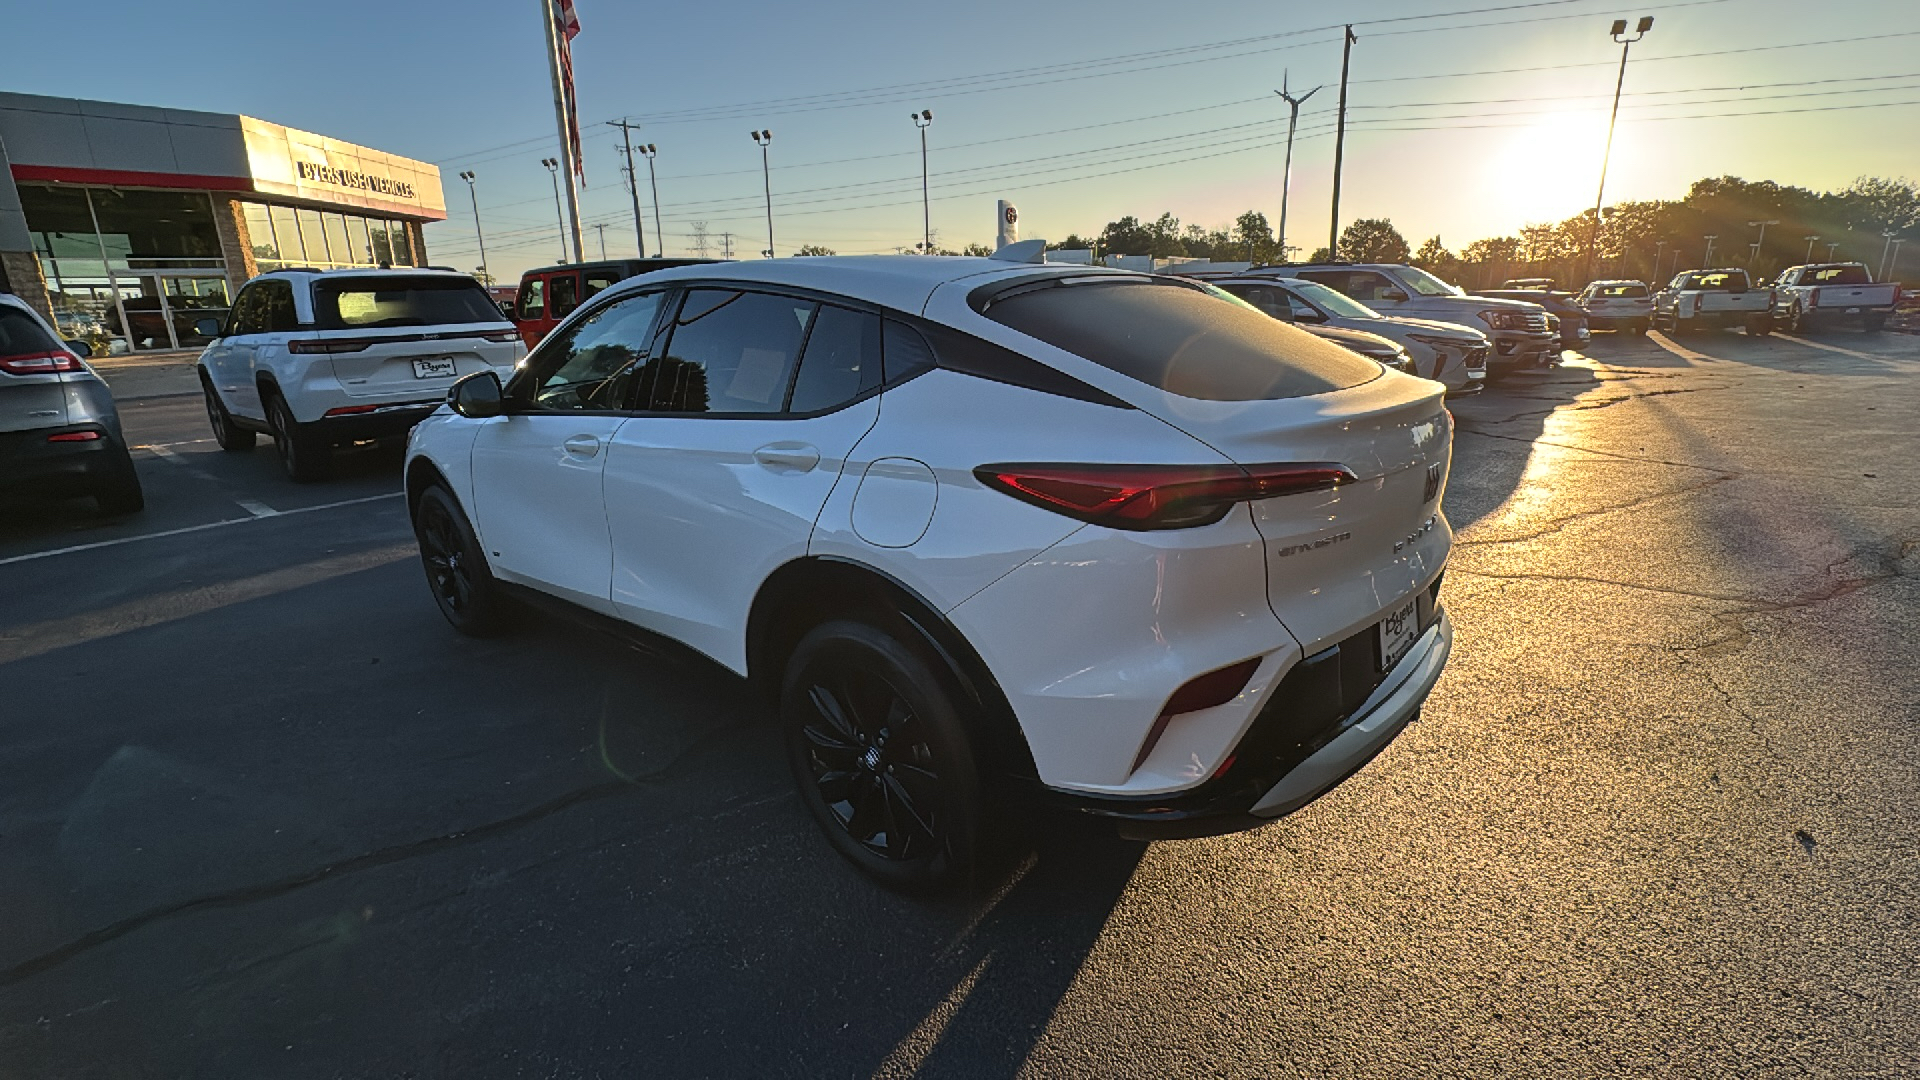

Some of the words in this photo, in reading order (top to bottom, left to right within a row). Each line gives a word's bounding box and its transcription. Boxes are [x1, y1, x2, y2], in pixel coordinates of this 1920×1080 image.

[299, 161, 340, 184] BYERS
[342, 170, 371, 189] USED
[371, 176, 415, 198] VEHICLES
[417, 361, 451, 372] Byers
[1381, 601, 1414, 636] Byers
